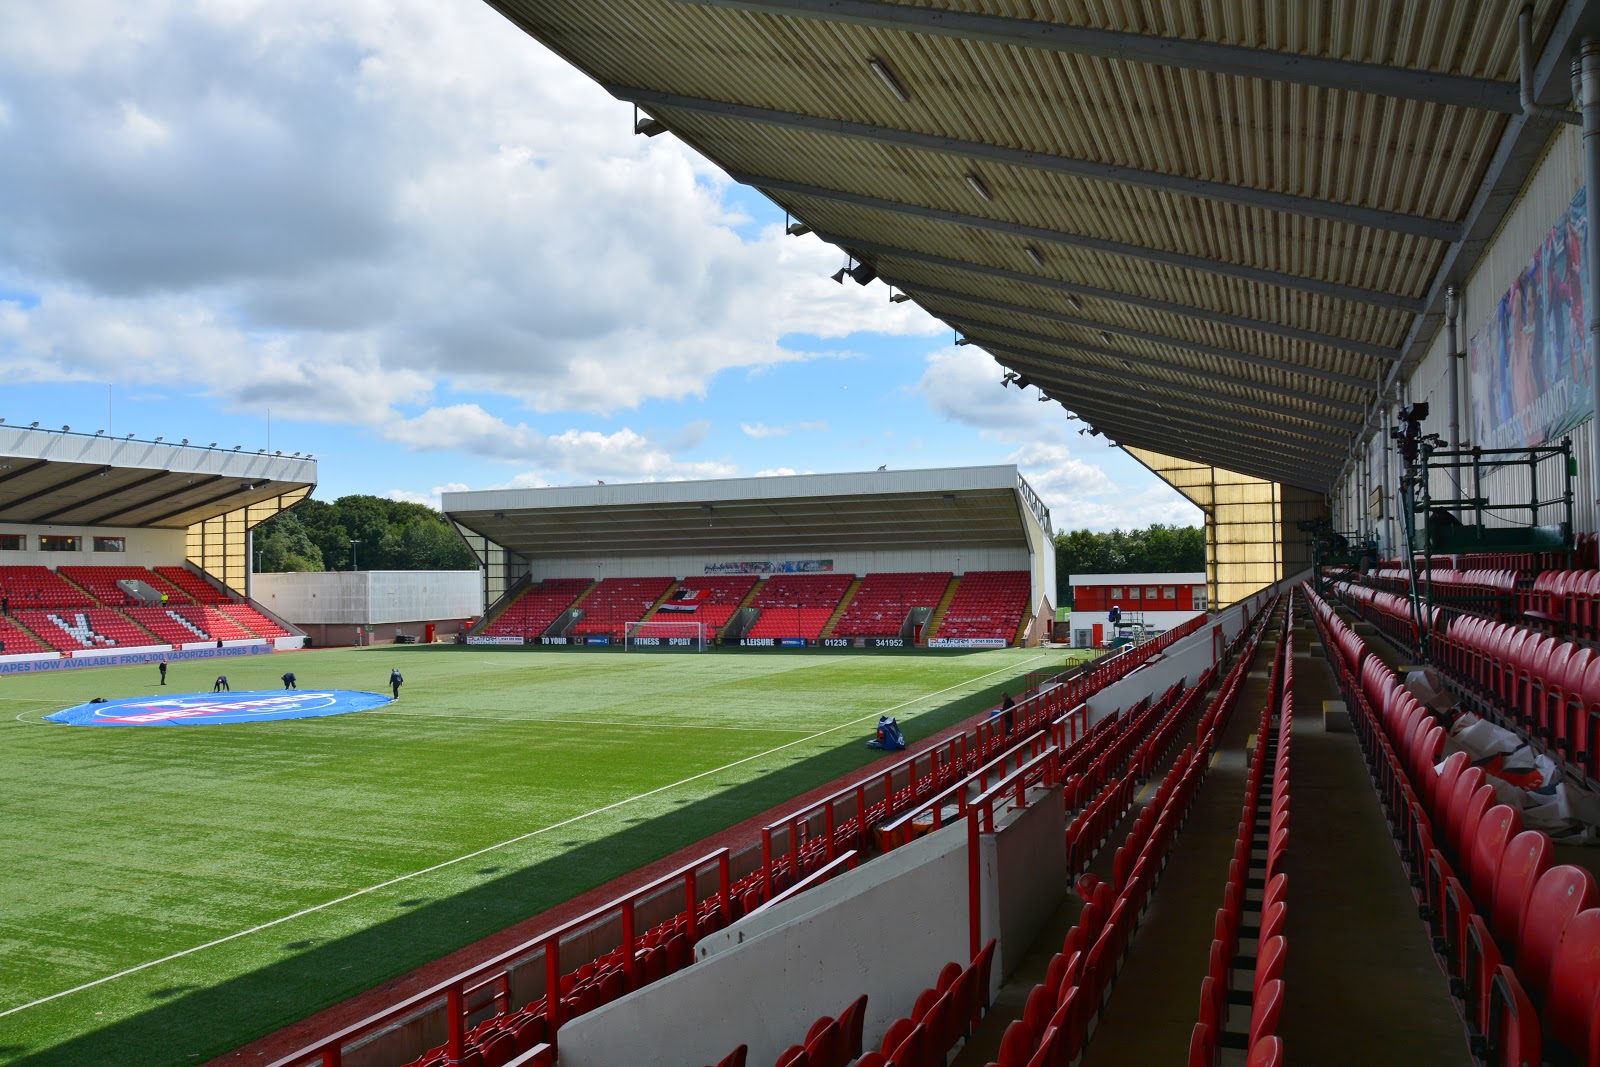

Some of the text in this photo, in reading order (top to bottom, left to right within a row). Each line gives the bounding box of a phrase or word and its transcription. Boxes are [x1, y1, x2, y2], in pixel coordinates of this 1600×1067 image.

[1522, 375, 1569, 435] COMMUNITY
[541, 637, 567, 645] TO YOUR
[634, 637, 691, 646] FITNESS SPORT
[747, 638, 775, 646] LEISURE
[824, 639, 903, 647] 01236 341952
[34, 661, 60, 670] NOW
[64, 656, 117, 669] AVAILABLE
[120, 654, 147, 664] FROM
[149, 653, 164, 662] 100
[167, 650, 214, 661] VAPORIZED
[217, 647, 247, 657] STORES
